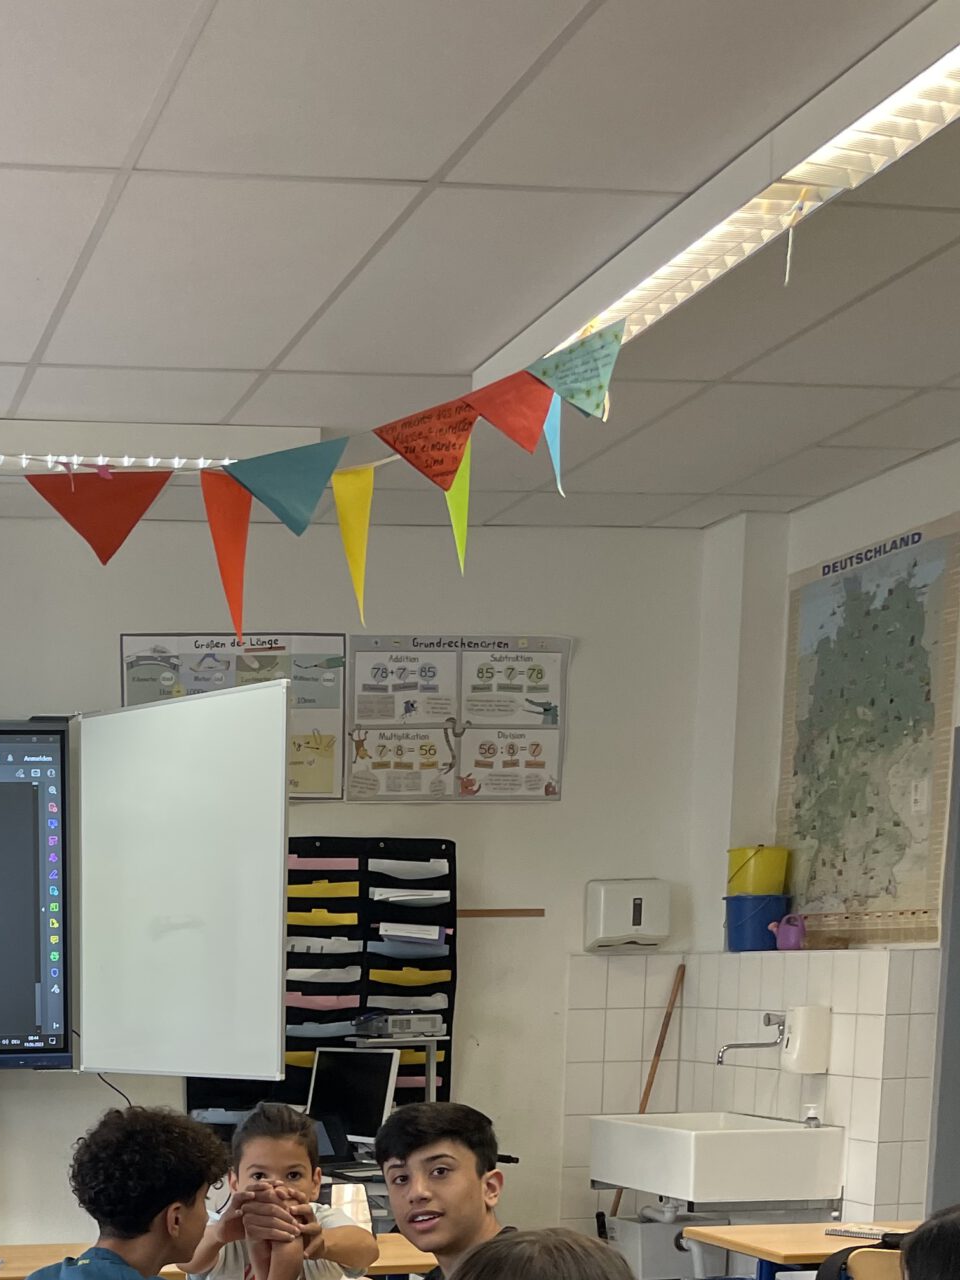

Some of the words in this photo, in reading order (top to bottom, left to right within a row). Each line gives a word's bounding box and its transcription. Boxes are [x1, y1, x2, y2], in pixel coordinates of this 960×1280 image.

[822, 532, 922, 576] DEUTSCHLAND
[250, 638, 279, 649] Länge
[412, 638, 509, 649] Grundrechenarten
[389, 655, 419, 663] Addition
[490, 654, 533, 662] Subtraktion
[372, 668, 388, 678] 78
[396, 668, 406, 678] 7
[420, 666, 436, 677] 85
[477, 668, 494, 678] 85
[506, 668, 516, 678] 7
[528, 668, 543, 680] 78
[379, 732, 429, 741] Multiplikation
[498, 731, 526, 739] Division
[377, 745, 386, 756] 7
[396, 745, 403, 756] 8
[420, 745, 437, 756] 56
[480, 744, 496, 755] 56
[508, 744, 516, 755] 8
[530, 744, 540, 755] 7
